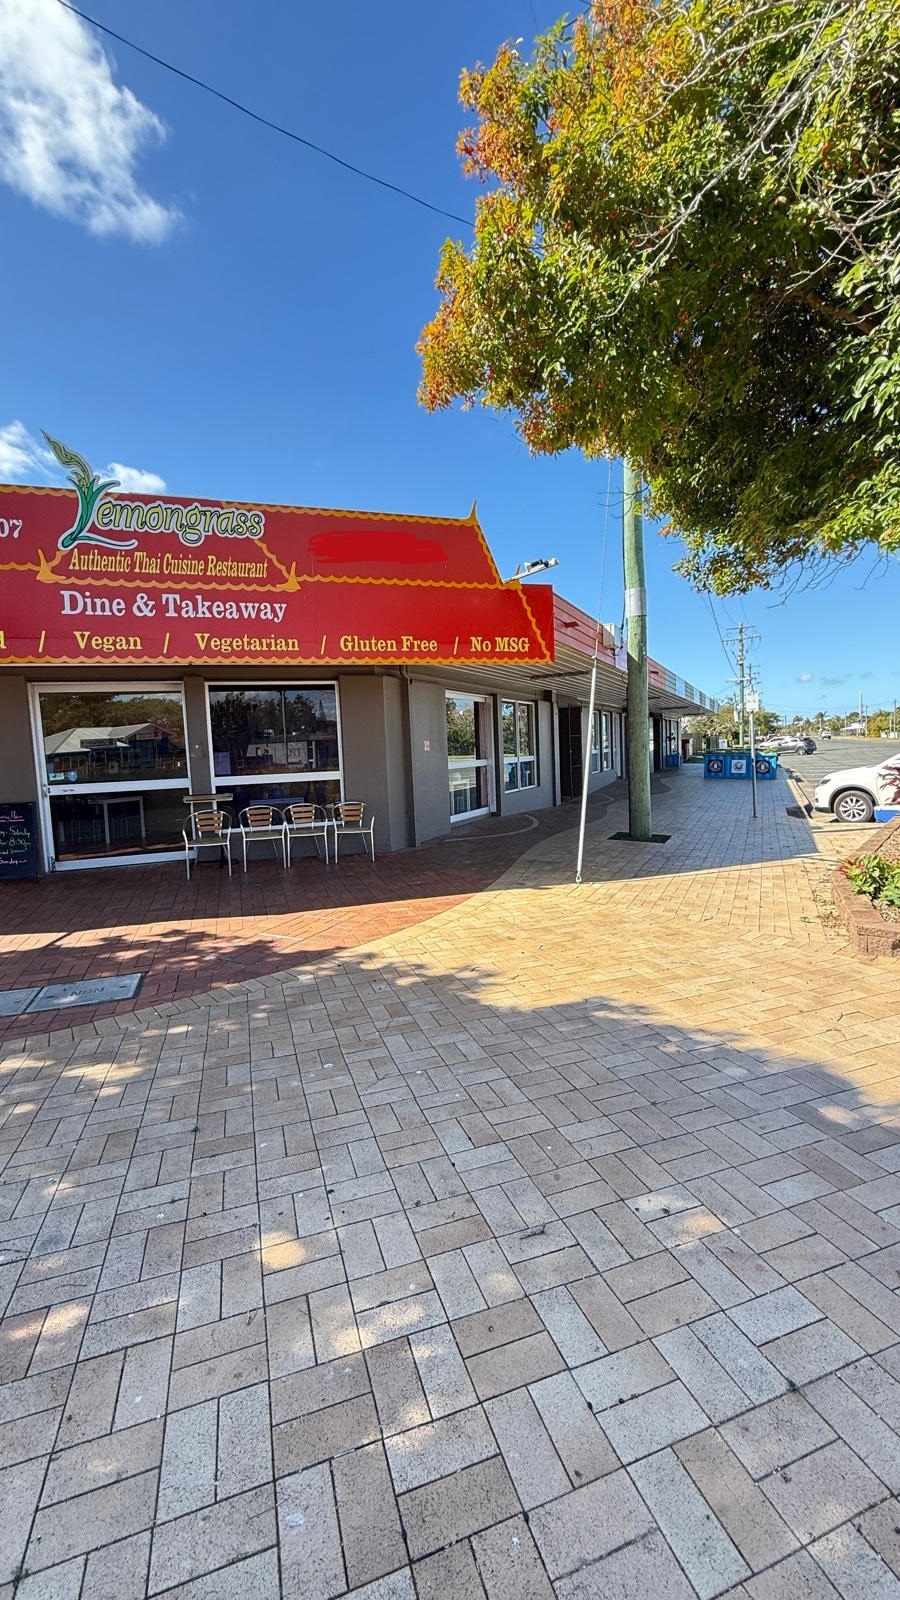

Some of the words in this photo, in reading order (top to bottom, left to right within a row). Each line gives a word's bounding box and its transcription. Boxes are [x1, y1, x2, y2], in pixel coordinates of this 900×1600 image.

[58, 475, 266, 551] Lemongrass
[69, 549, 131, 573] Authentic
[133, 551, 161, 574] Thai
[163, 553, 205, 575] Cuisine
[207, 556, 268, 578] Restaurant
[60, 590, 126, 616] Dine
[132, 593, 156, 617] &
[162, 593, 287, 623] Takeaway
[73, 631, 142, 652] Vegan
[194, 633, 300, 653] Vegetarian
[340, 635, 398, 653] Gluten
[401, 636, 438, 652] Free
[470, 637, 491, 653] No
[495, 637, 530, 653] MSG
